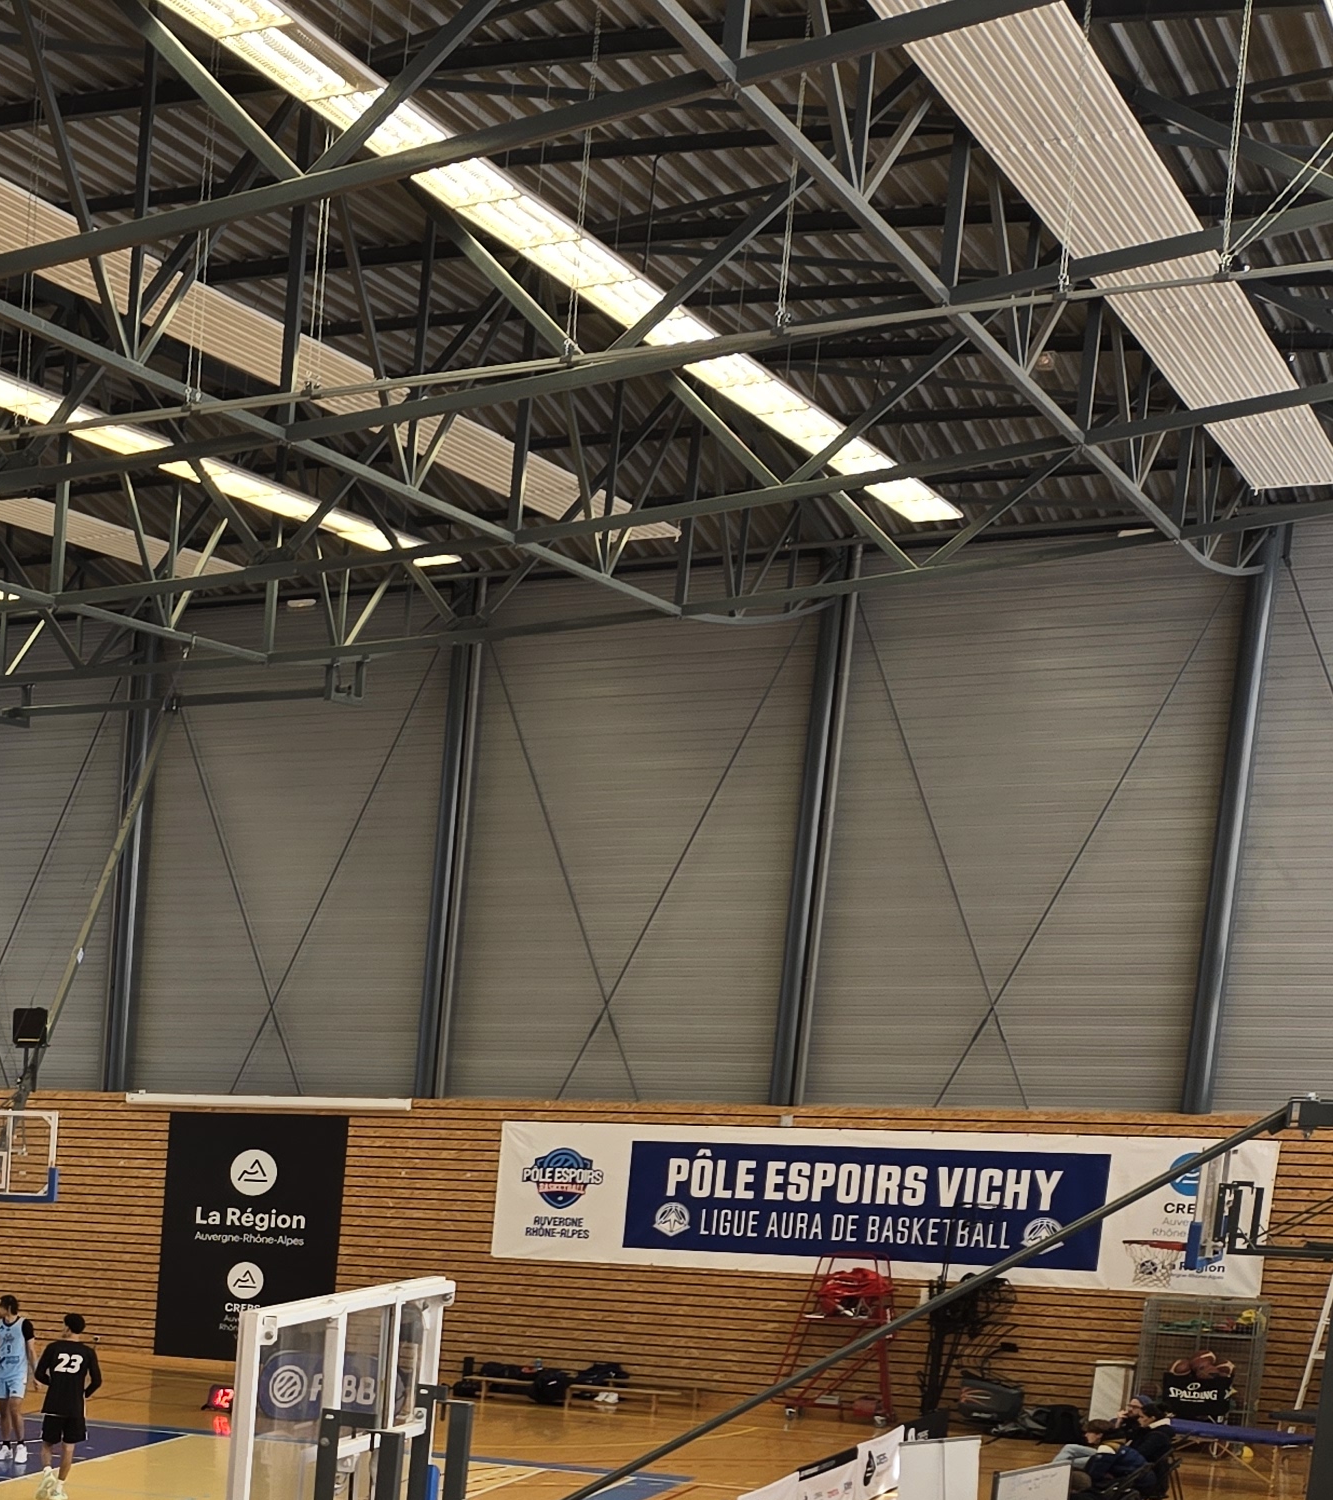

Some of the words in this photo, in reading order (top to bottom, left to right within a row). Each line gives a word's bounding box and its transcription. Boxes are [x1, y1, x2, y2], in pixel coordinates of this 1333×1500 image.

[523, 1165, 554, 1183] PÔLE
[554, 1168, 604, 1185] ESPOIRS
[665, 1148, 755, 1200] PÔLE
[763, 1162, 929, 1206] ESPOIRS
[938, 1167, 1065, 1211] VICHY
[196, 1206, 221, 1225] La
[226, 1207, 306, 1231] Région
[1164, 1203, 1195, 1214] CRE
[533, 1215, 584, 1227] AUVERGNE
[699, 1209, 759, 1238] LIGUE
[765, 1212, 823, 1240] AURA
[831, 1215, 858, 1242] DE
[866, 1216, 1011, 1249] BASKETBALL
[194, 1231, 304, 1247] Auvergne-Rhône-Alpes
[525, 1225, 590, 1239] RHÔNE-ALPES
[54, 1353, 83, 1373] 23
[309, 1374, 376, 1405] FBB
[1169, 1387, 1218, 1400] SPALDING
